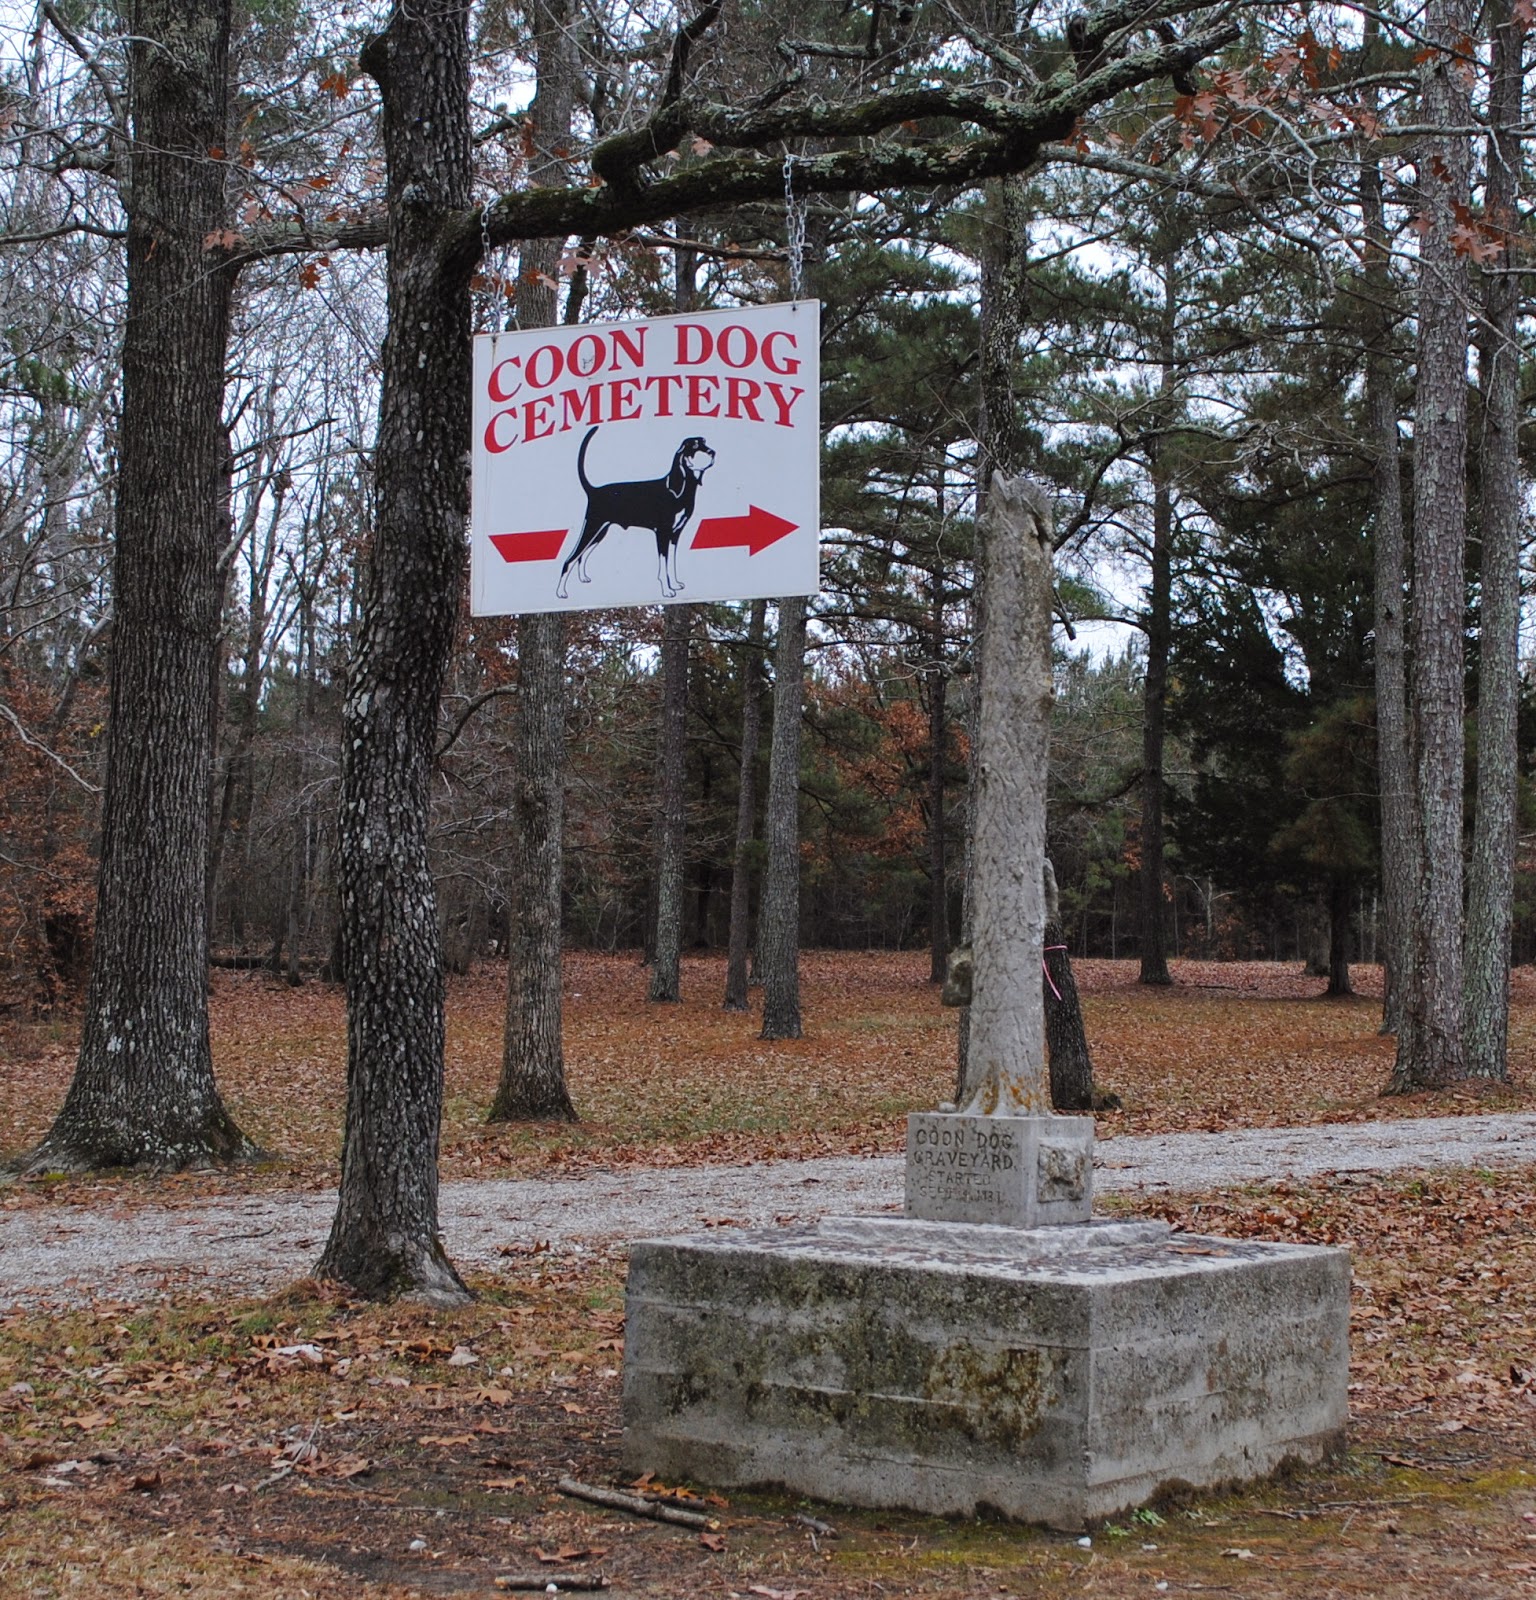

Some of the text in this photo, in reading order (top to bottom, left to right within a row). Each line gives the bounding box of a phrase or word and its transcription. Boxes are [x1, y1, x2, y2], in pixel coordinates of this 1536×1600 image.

[487, 324, 801, 402] COON DOG
[483, 375, 805, 454] CEMETERY
[916, 1128, 1014, 1150] COON DOG
[913, 1150, 1014, 1171] GRAVEYARD
[928, 1170, 991, 1186] STARTED
